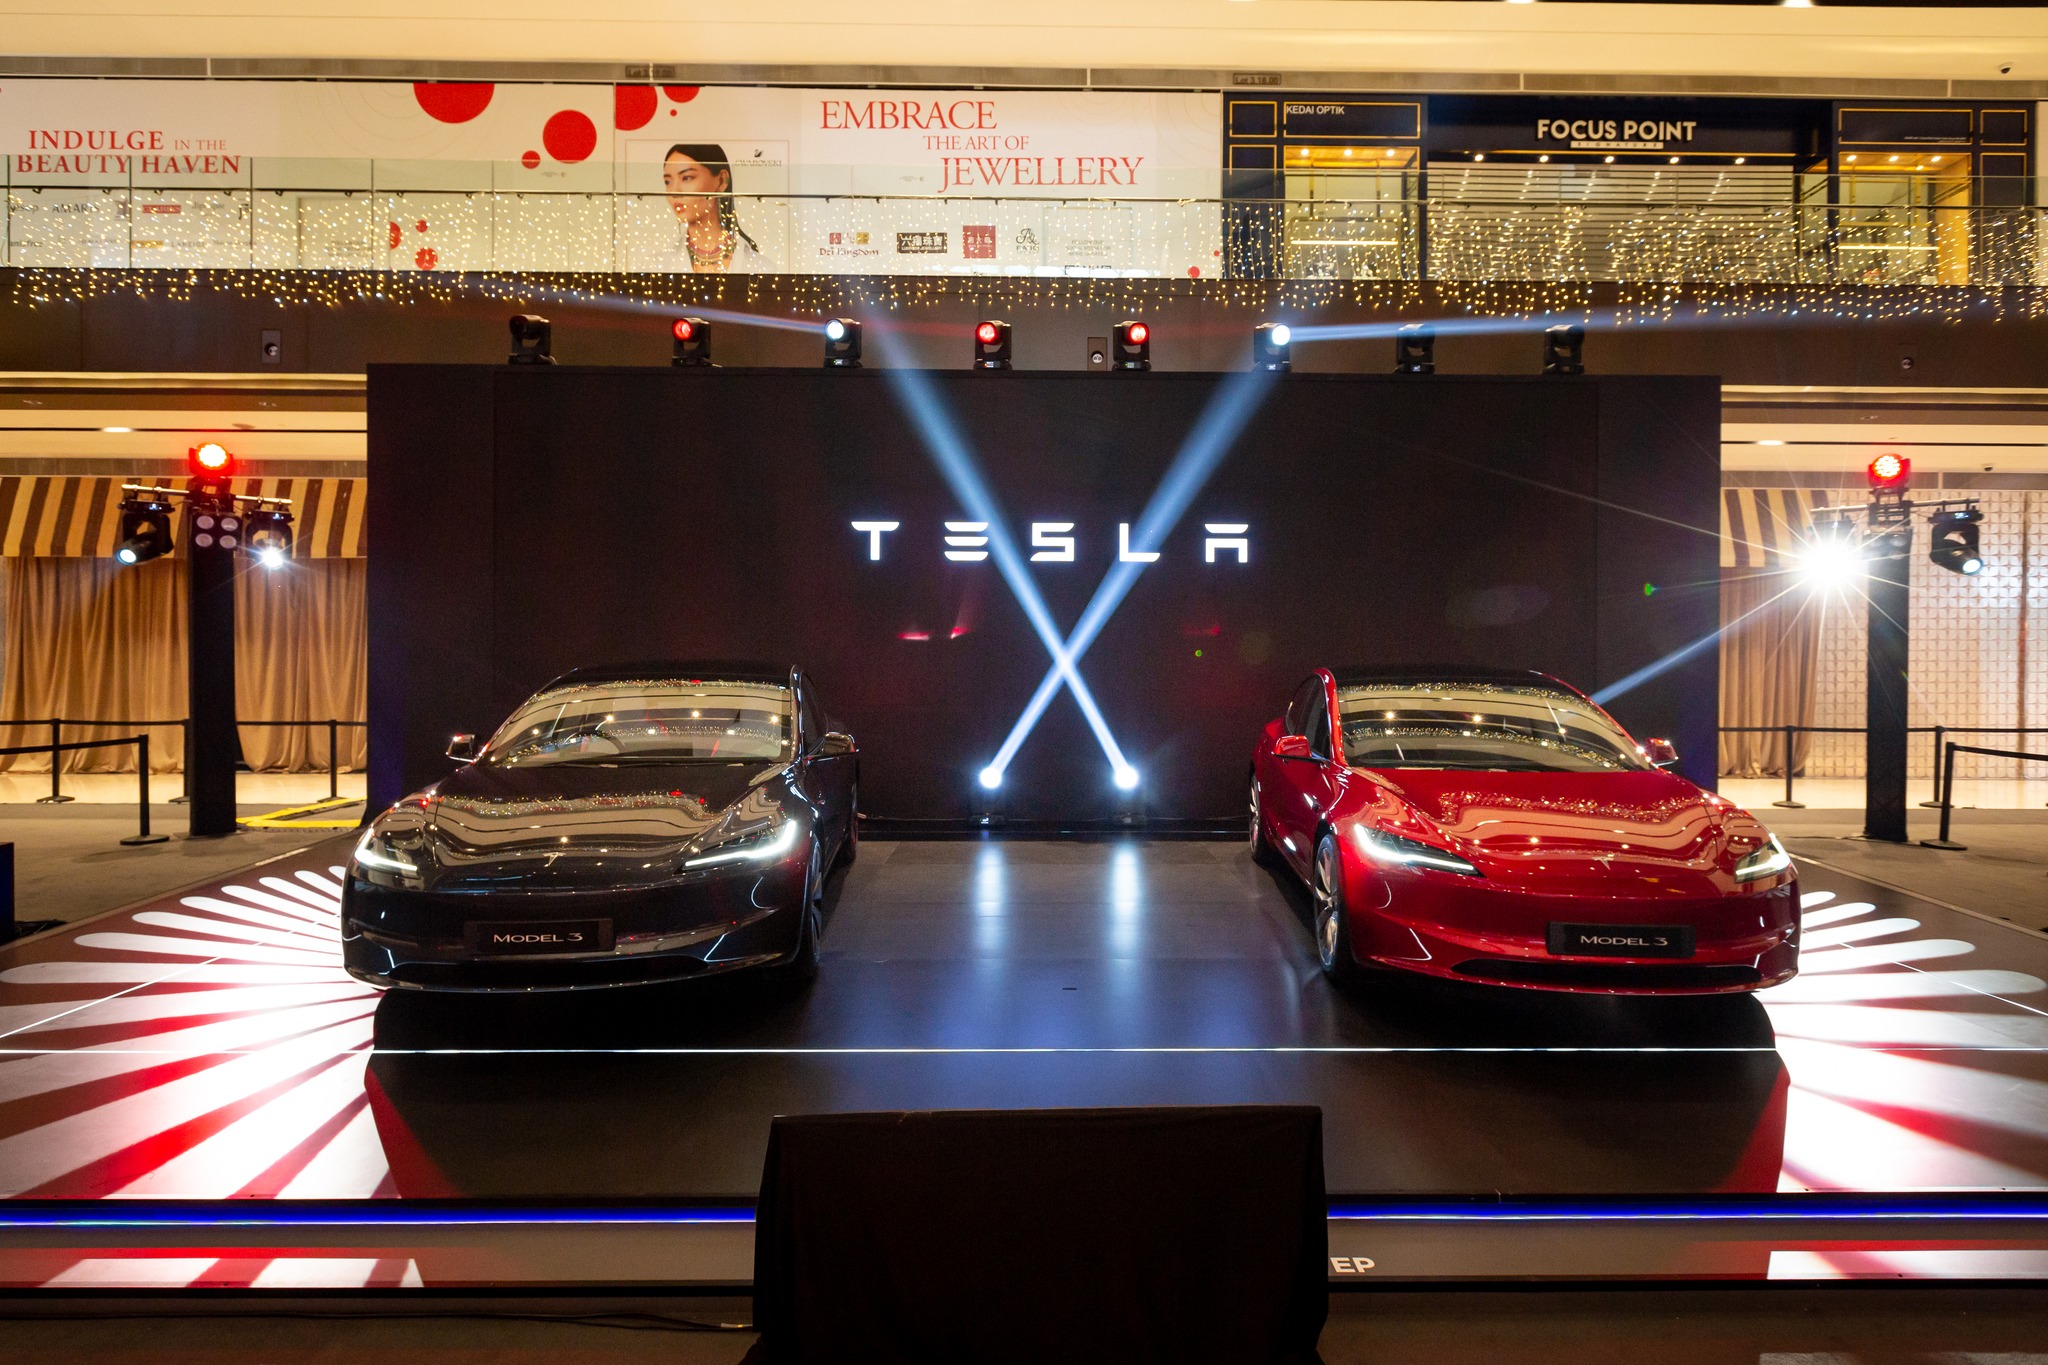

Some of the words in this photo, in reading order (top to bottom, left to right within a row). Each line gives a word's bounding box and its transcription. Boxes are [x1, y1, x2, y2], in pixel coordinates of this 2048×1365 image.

[820, 100, 998, 130] EMBRACE
[1286, 105, 1315, 115] KEDAI
[1317, 105, 1345, 115] OPTIK
[1537, 119, 1617, 140] FOCUS
[1623, 120, 1697, 141] POINT
[29, 130, 164, 150] INDULGE
[175, 140, 190, 150] IN
[195, 140, 227, 150] THE
[922, 135, 961, 150] THE
[966, 135, 1001, 150] ART
[1004, 135, 1029, 150] OF
[16, 155, 129, 173] BEAUTY
[140, 156, 240, 174] HAVEN
[937, 157, 1144, 193] JEWELLERY
[851, 521, 1249, 563] TESLA
[493, 934, 564, 943] MODEL
[567, 932, 583, 942] 3
[1580, 935, 1650, 946] MODEL
[1654, 937, 1668, 946] 3
